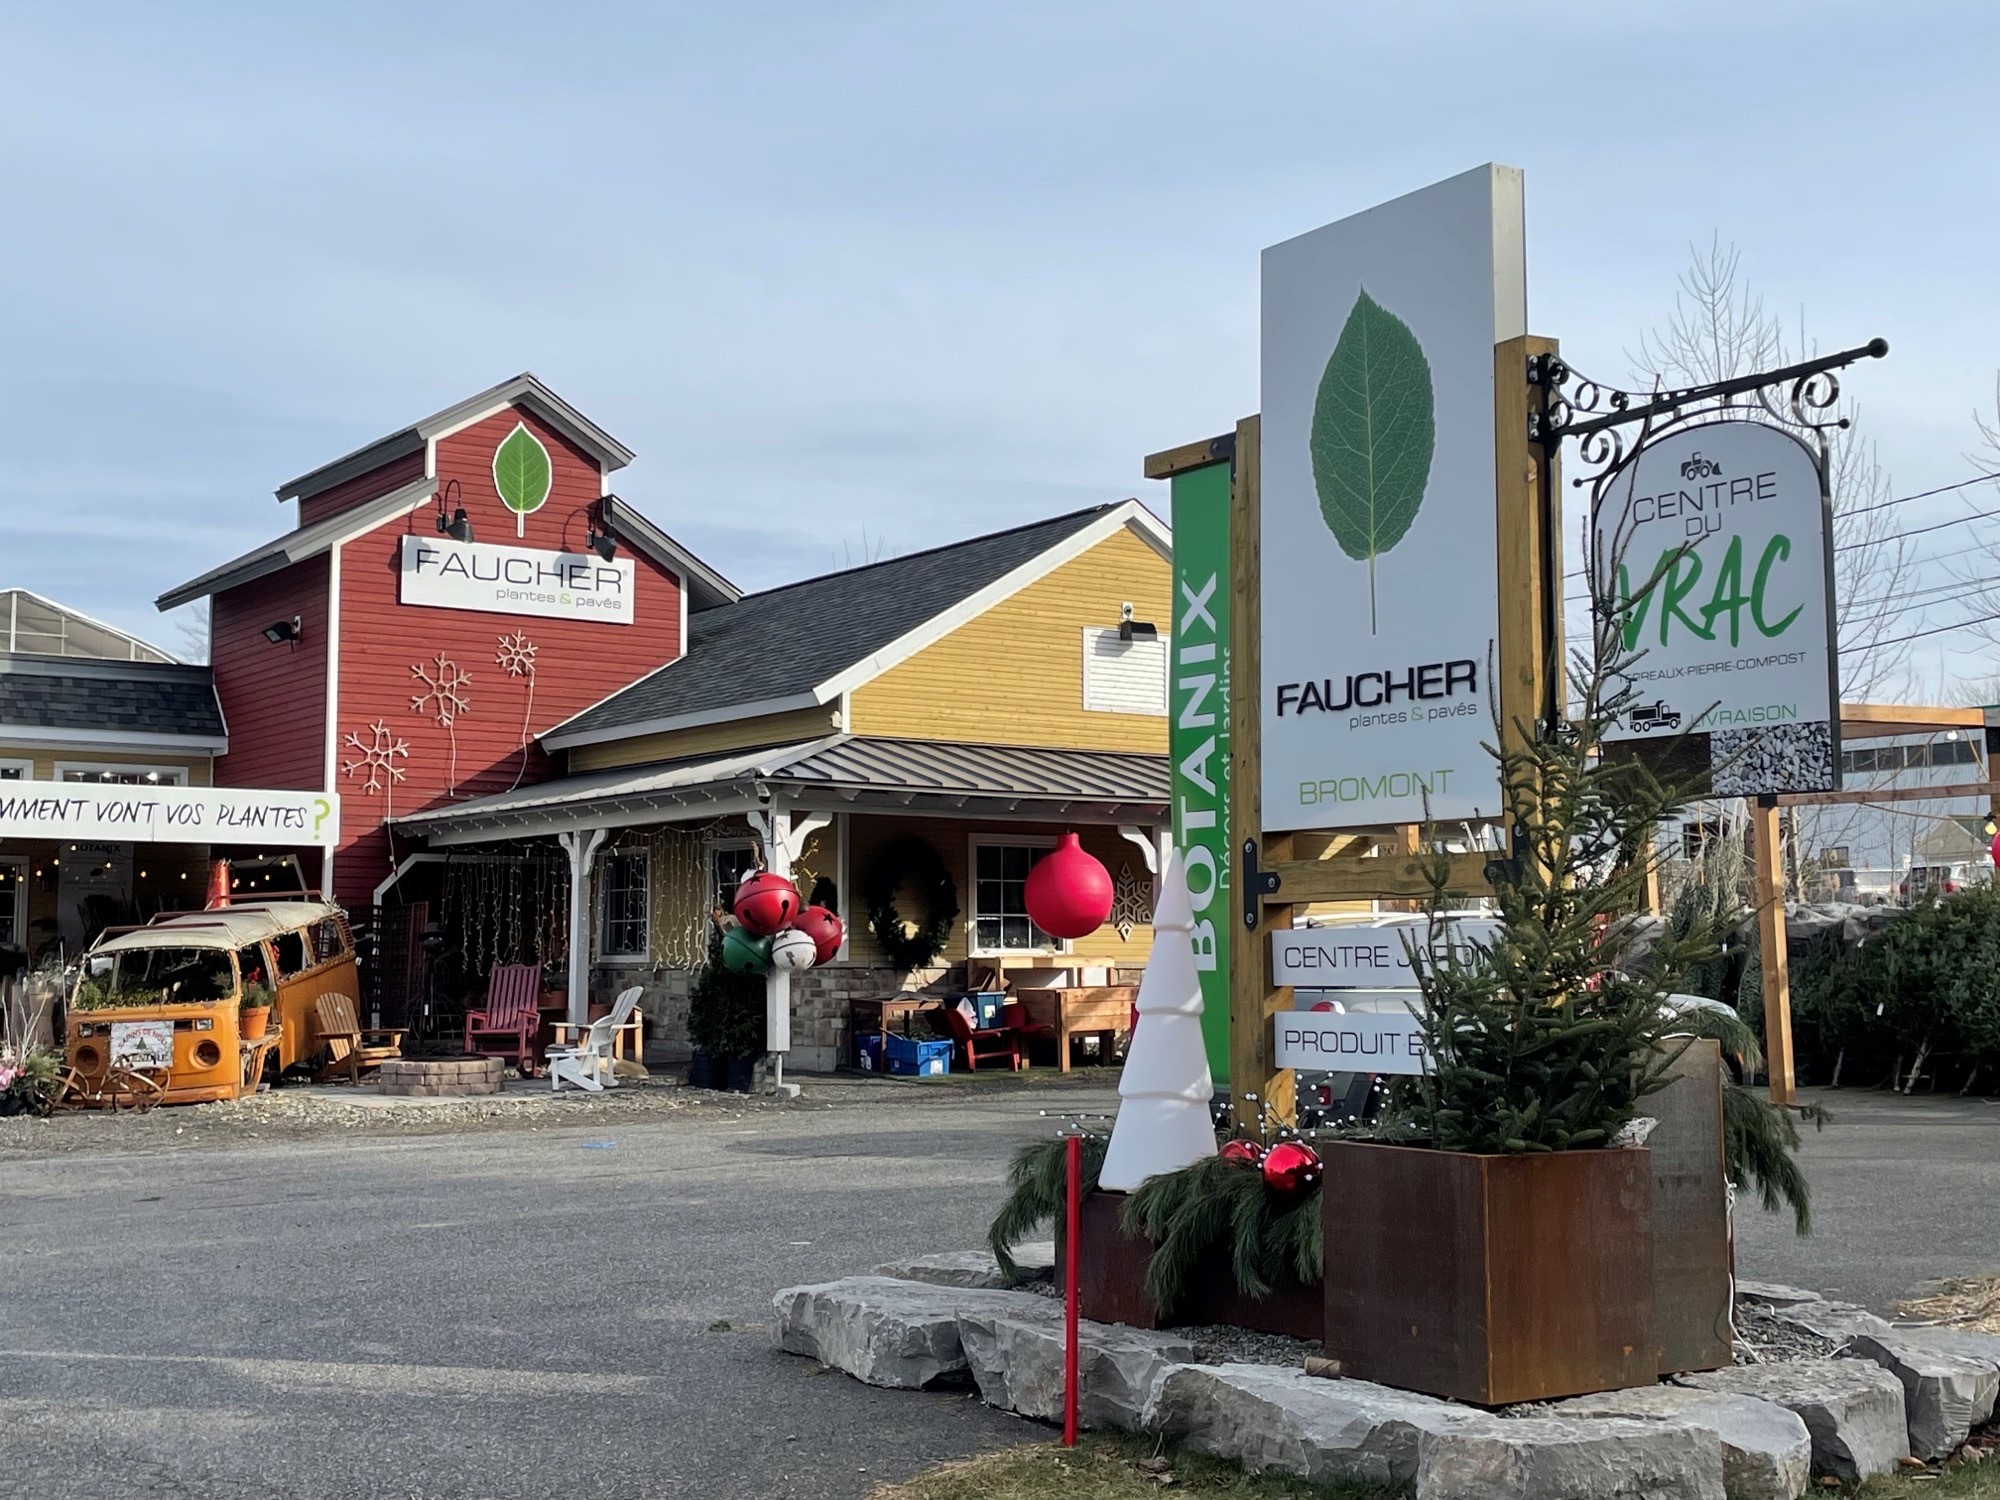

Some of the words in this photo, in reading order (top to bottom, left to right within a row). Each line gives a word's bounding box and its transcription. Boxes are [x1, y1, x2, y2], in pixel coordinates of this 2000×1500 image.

[1633, 472, 1777, 523] CENTRE
[1685, 513, 1722, 536] DU
[416, 549, 622, 594] FAUCHER
[496, 588, 556, 604] plantes
[559, 593, 572, 605] &
[575, 596, 622, 610] pavés
[1617, 534, 1805, 651] VRAC
[1277, 659, 1477, 717] FAUCHER
[1350, 711, 1408, 731] plantes
[1411, 706, 1425, 721] &
[1428, 702, 1478, 723] pavés
[1690, 703, 1797, 728] LIVRAISON
[1179, 571, 1217, 972] BOTANIX
[1299, 769, 1455, 805] BROMONT
[96, 800, 160, 824] VONT
[166, 803, 205, 825] VOS
[216, 804, 307, 828] PLANTES
[1284, 946, 1389, 968] CENTRE
[1285, 1030, 1401, 1055] PRODUIT
